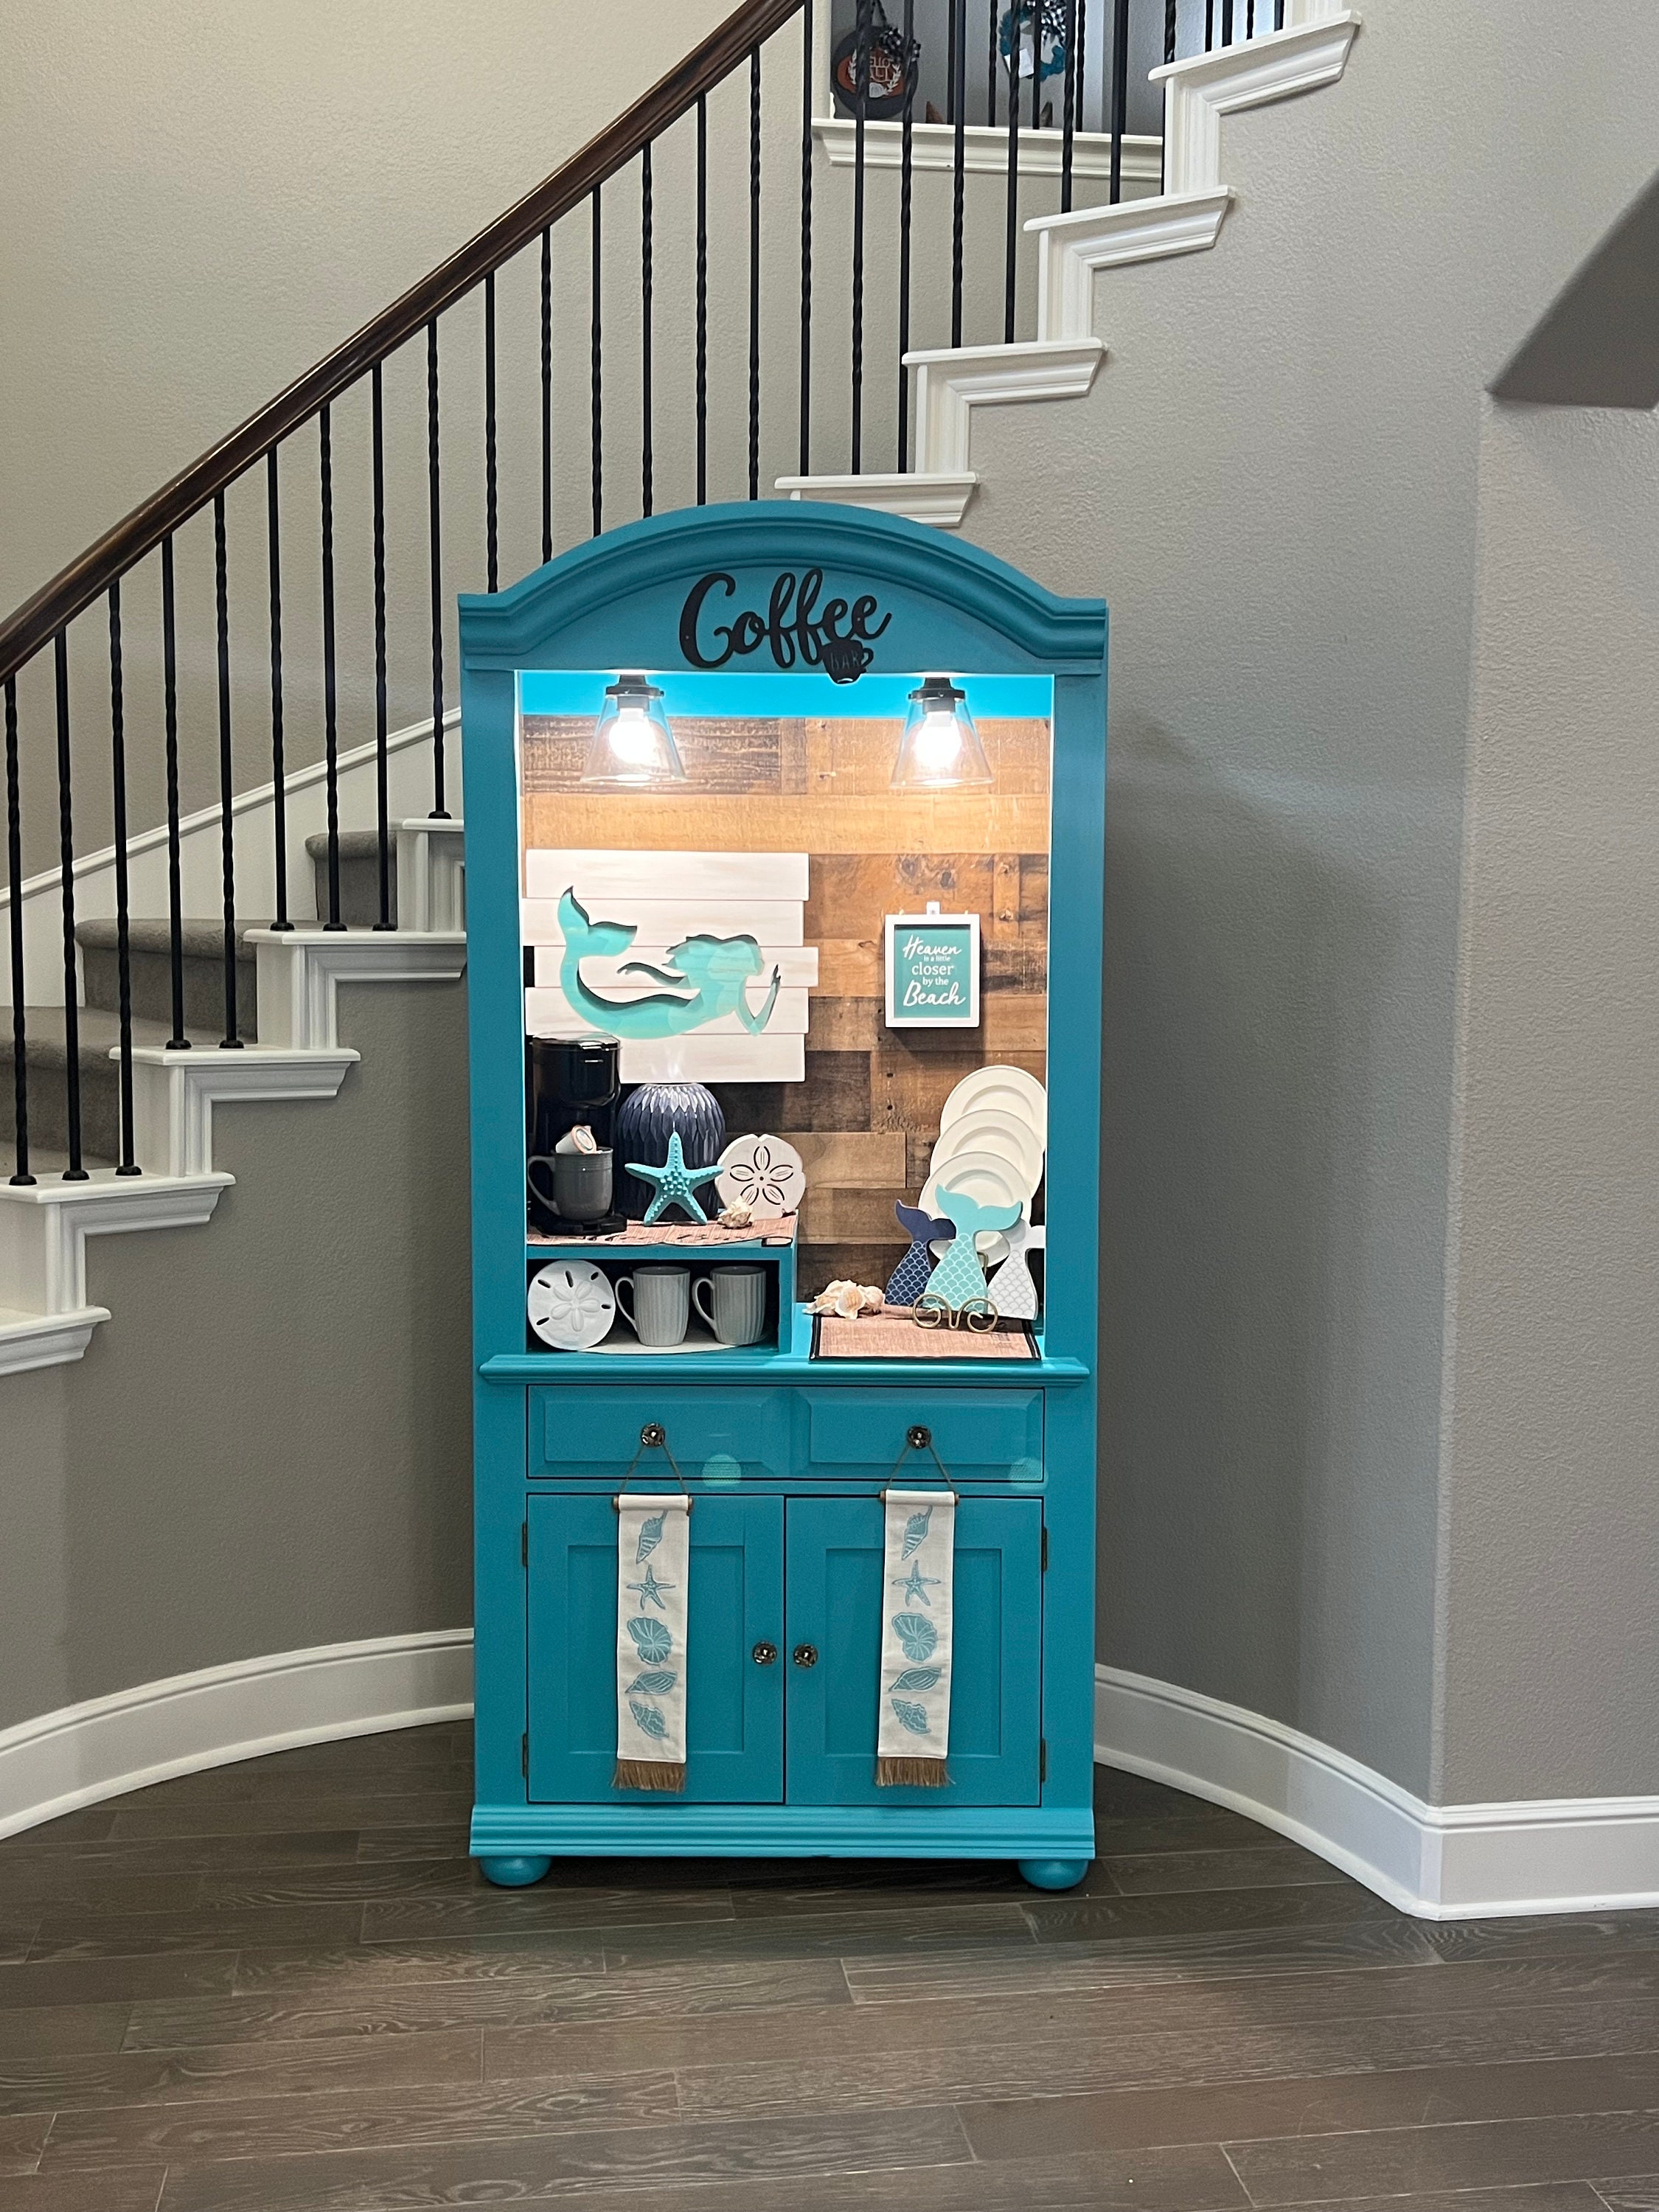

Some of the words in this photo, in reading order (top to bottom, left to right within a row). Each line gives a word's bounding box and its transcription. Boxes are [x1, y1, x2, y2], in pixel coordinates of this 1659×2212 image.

[679, 568, 891, 668] Coffee
[830, 650, 860, 671] BAR
[902, 934, 962, 960] Heaven
[911, 961, 954, 975] closer
[902, 979, 967, 1006] Beach
[922, 976, 933, 987] by
[935, 976, 949, 985] the
